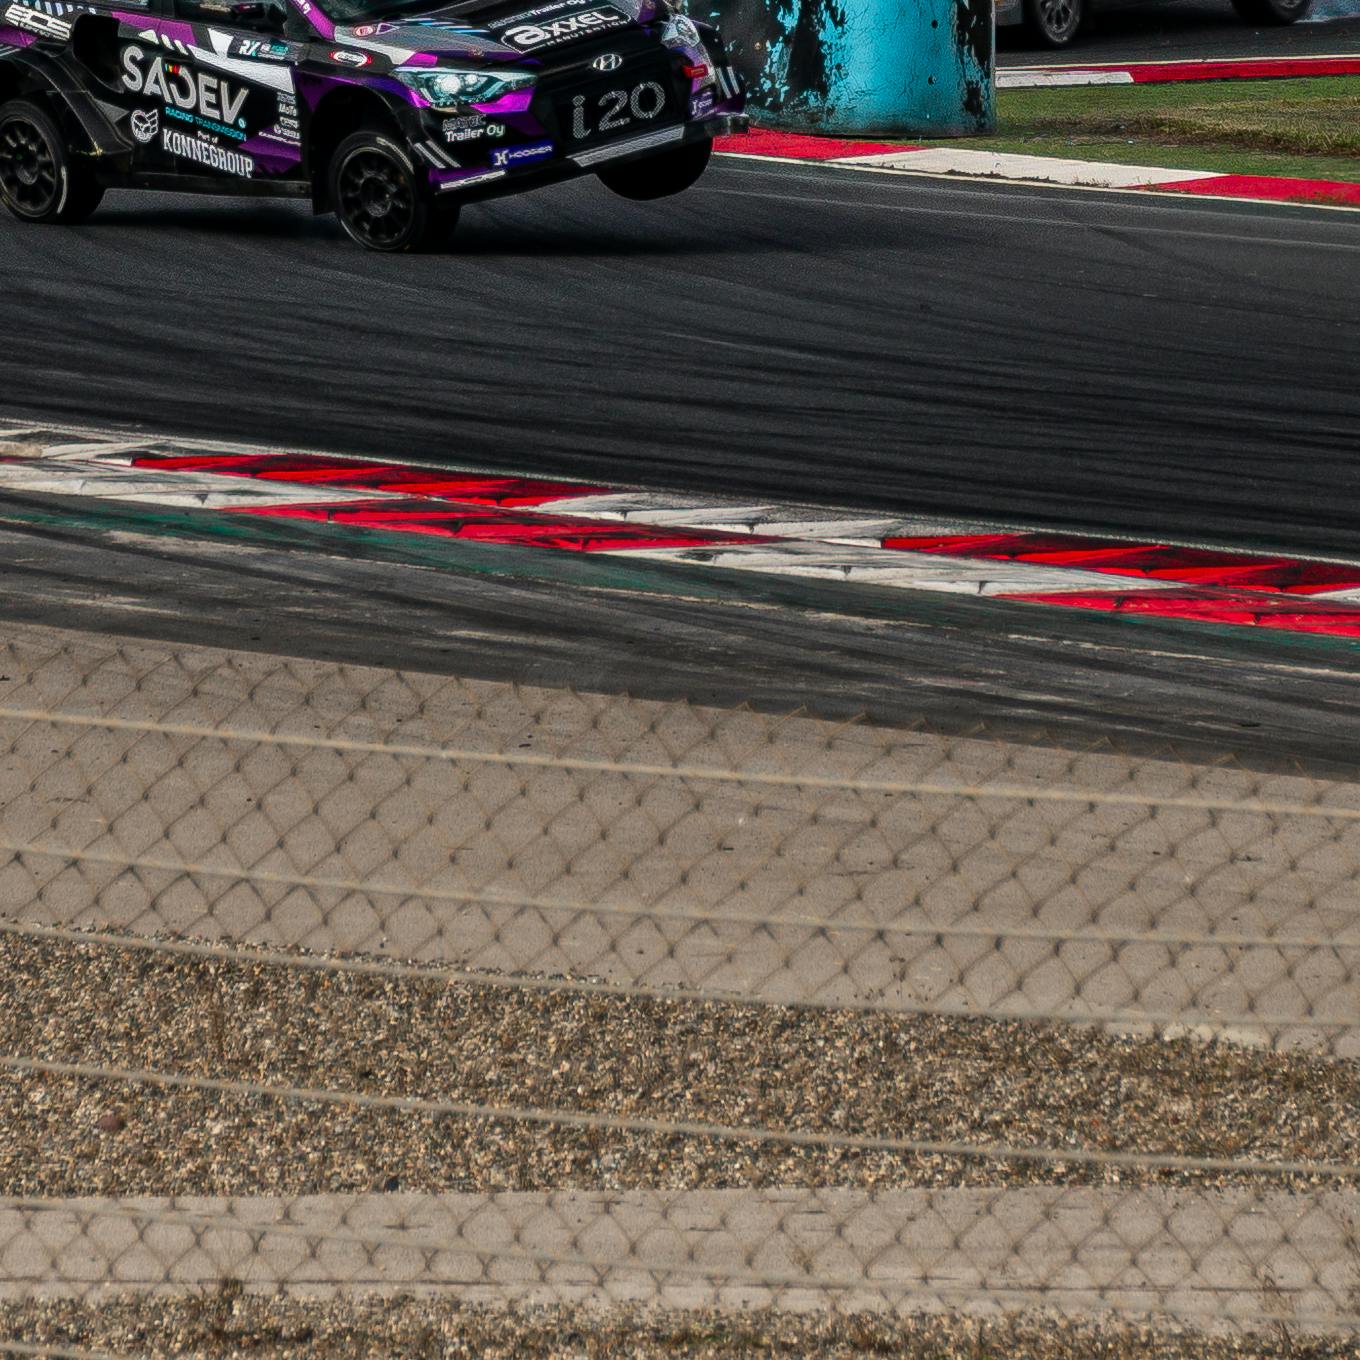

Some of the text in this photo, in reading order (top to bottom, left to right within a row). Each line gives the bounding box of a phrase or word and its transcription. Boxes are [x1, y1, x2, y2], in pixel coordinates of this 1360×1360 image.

[531, 3, 566, 16] Trailer
[121, 46, 250, 125] SADEV
[164, 106, 194, 125] RACING
[444, 124, 505, 142] Trailer Oy
[162, 128, 254, 179] KONNEGROUP
